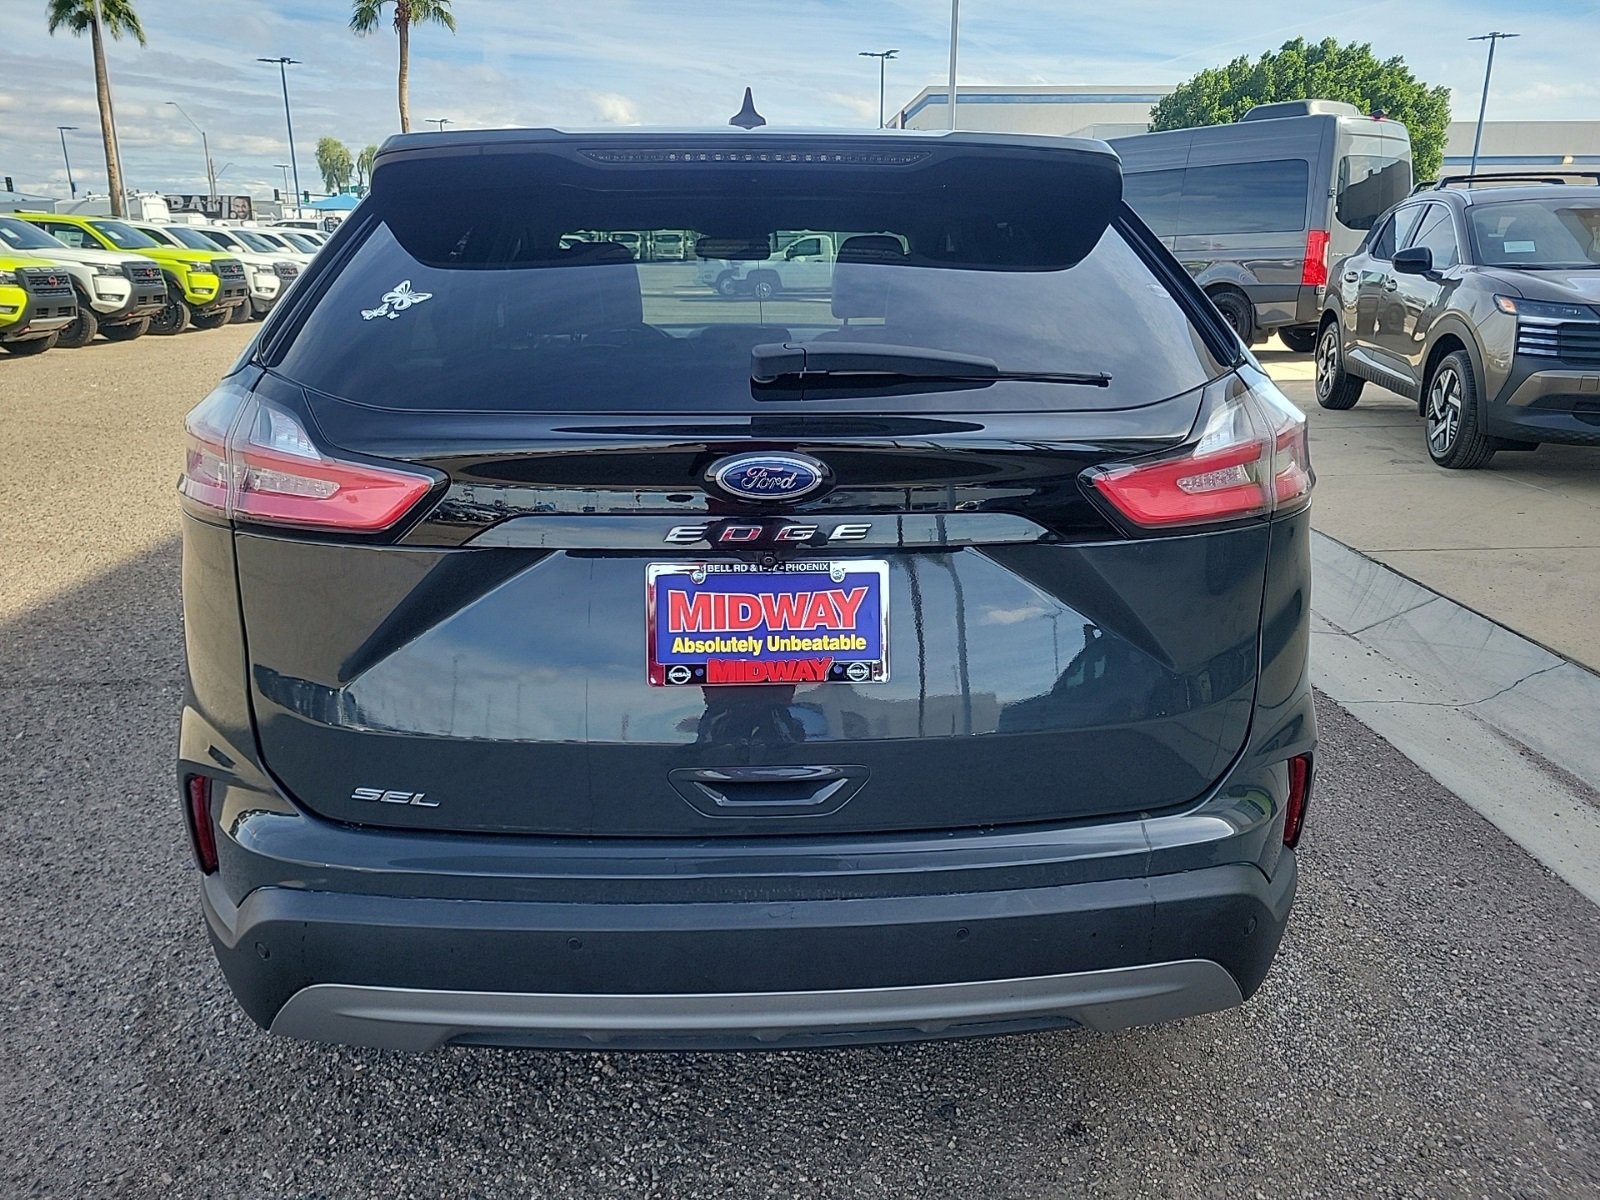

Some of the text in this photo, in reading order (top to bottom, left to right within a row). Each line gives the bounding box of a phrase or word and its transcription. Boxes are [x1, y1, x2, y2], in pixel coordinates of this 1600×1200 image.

[741, 466, 798, 490] Ford
[663, 523, 872, 542] EDGE
[707, 564, 733, 573] BELL
[733, 564, 749, 573] RD
[749, 564, 757, 573] &
[785, 562, 829, 572] PHOENIX
[668, 587, 869, 633] MIDWAY
[672, 634, 867, 656] Absolutely Unbeatable
[706, 658, 834, 683] MIDWAY
[351, 787, 441, 807] SEL
